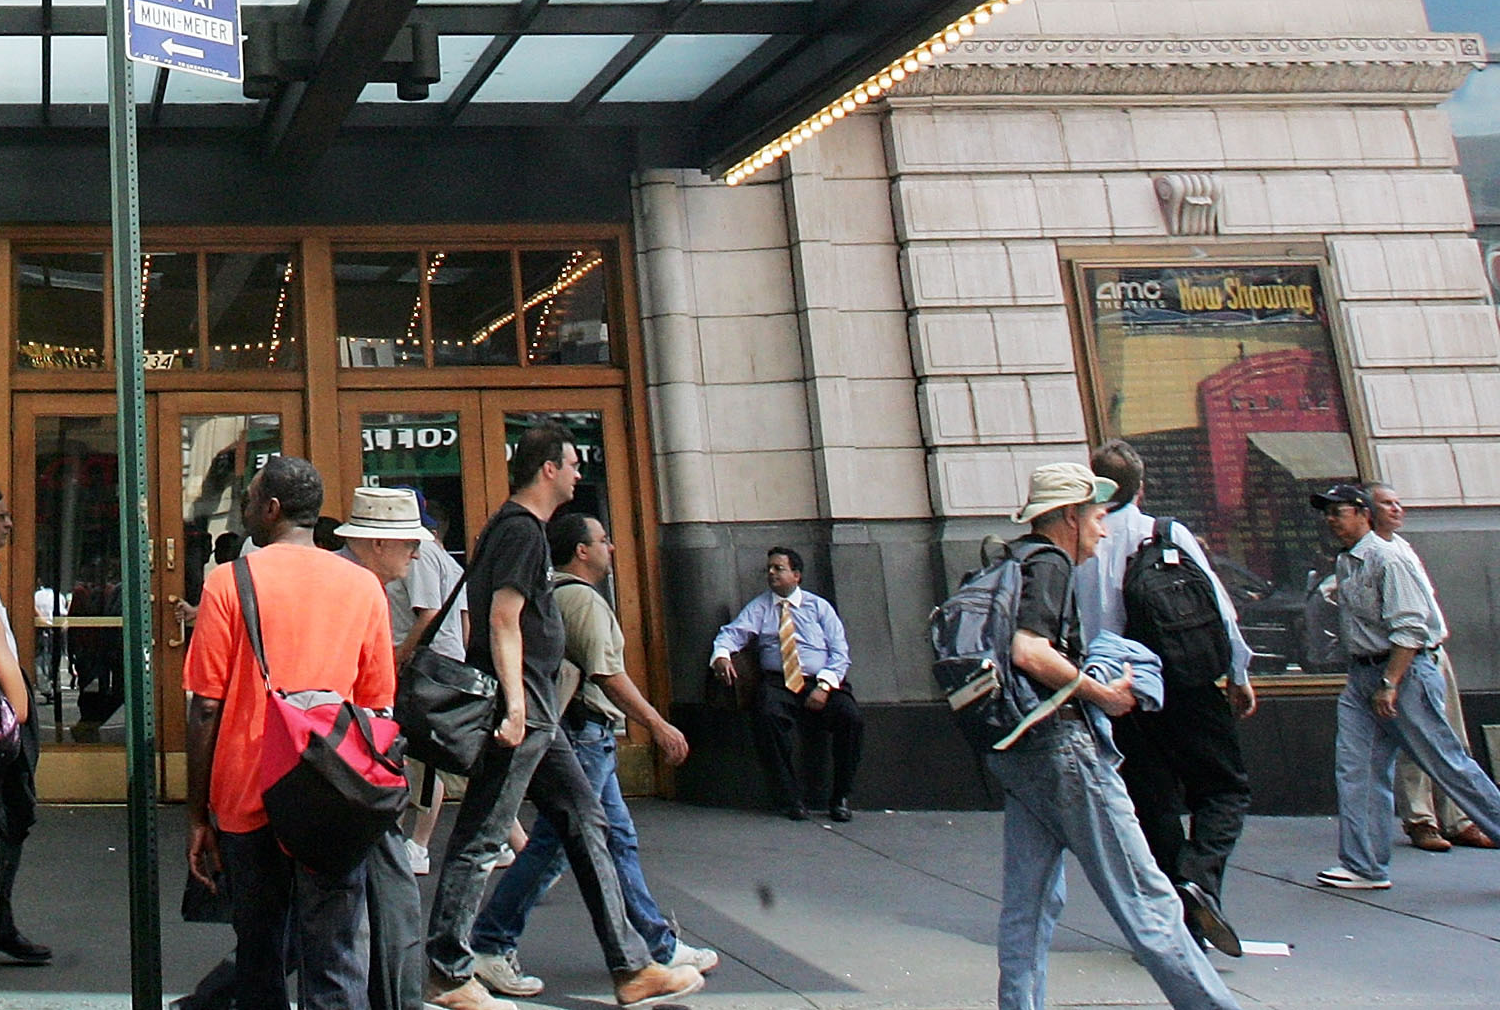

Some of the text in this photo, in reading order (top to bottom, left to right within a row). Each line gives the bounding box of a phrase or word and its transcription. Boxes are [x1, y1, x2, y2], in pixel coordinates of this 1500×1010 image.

[140, 6, 228, 41] MUNI-METER
[1096, 300, 1167, 309] THEATRES
[1176, 277, 1314, 315] Now Showing
